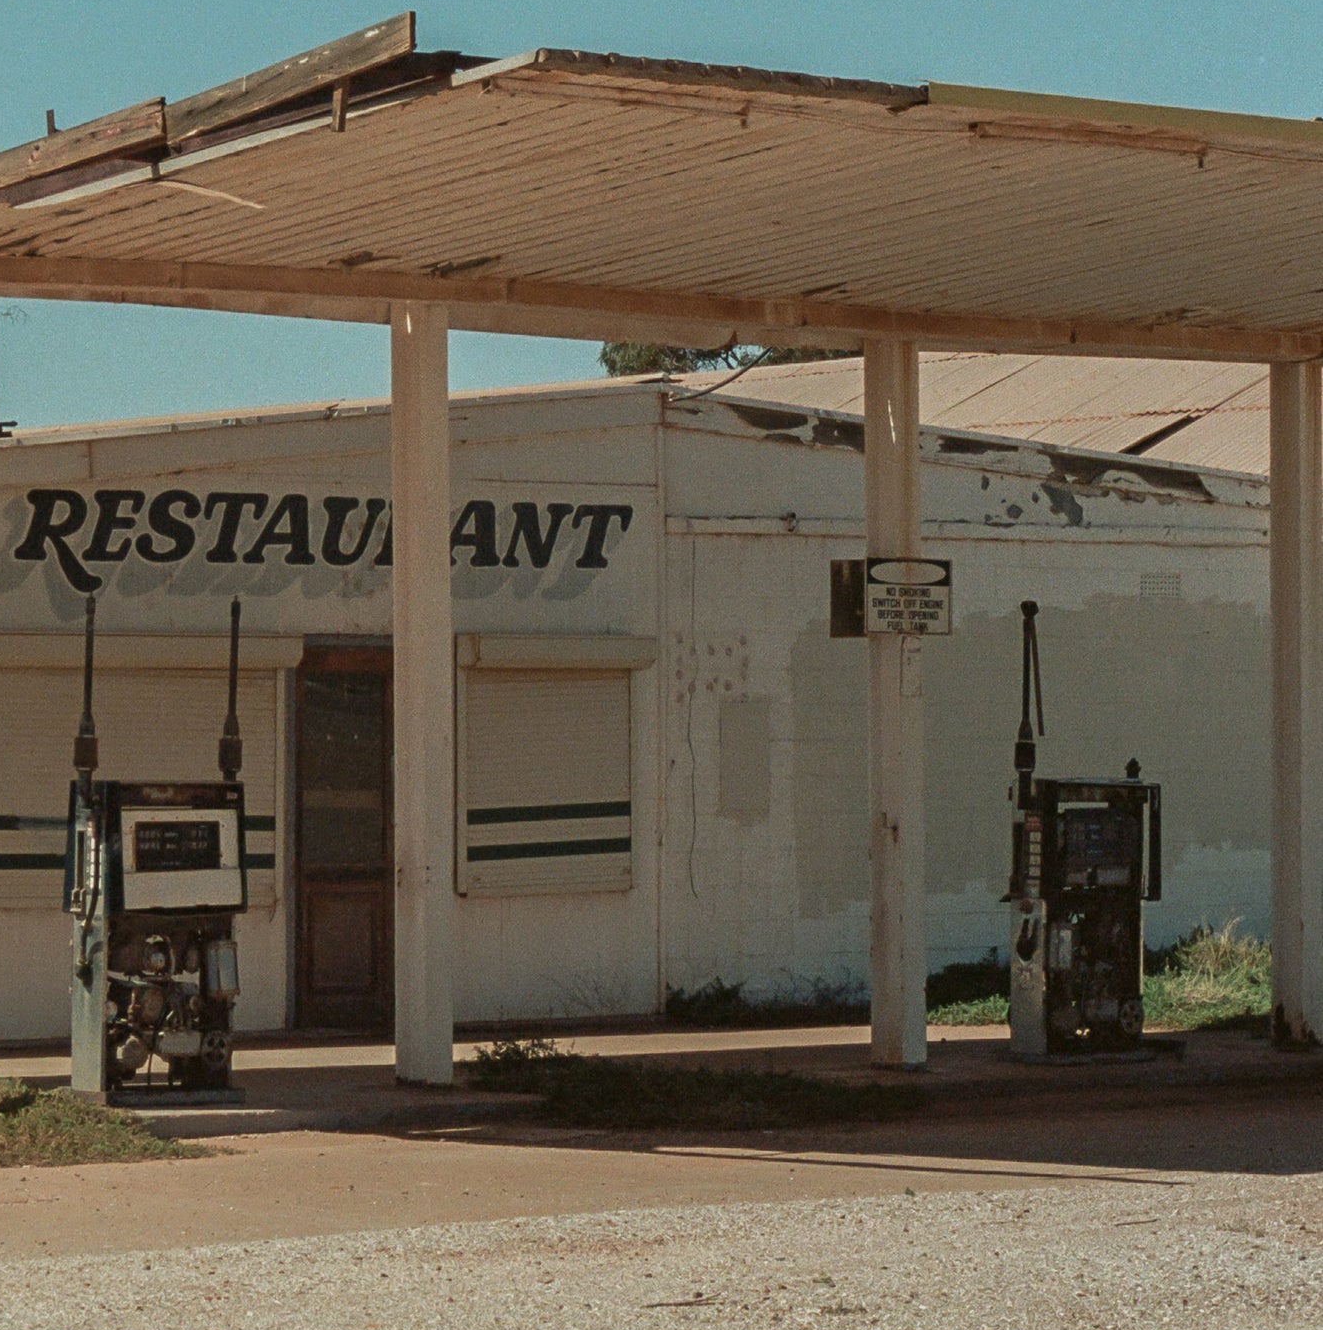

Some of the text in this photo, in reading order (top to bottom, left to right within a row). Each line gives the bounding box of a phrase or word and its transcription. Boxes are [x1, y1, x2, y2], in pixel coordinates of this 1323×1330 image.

[886, 587, 930, 598] NO SMOKING
[872, 598, 943, 609] SWITCH OFF ENGINE
[877, 610, 939, 620] BEFORE OPENING
